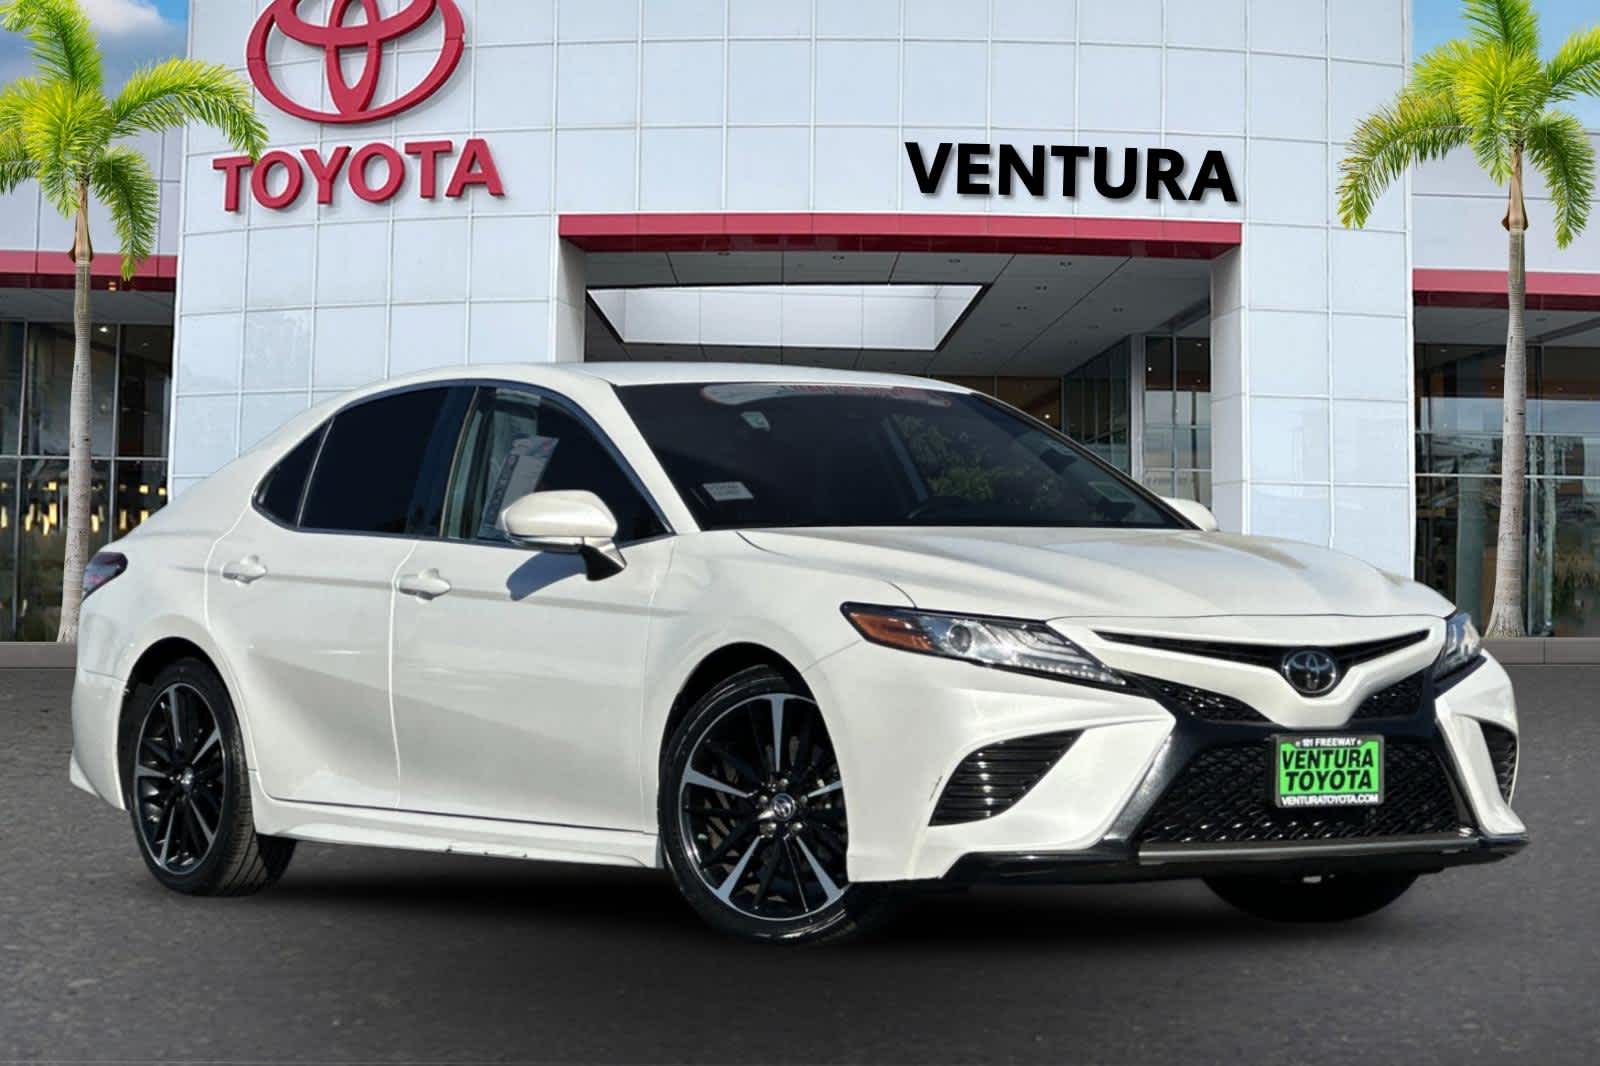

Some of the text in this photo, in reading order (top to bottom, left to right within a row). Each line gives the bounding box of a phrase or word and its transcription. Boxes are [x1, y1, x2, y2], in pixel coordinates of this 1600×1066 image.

[212, 138, 505, 212] TOYOTA
[905, 141, 1238, 203] VENTURA
[1315, 737, 1356, 746] FREEWAY
[1282, 749, 1373, 769] VENTURA
[1286, 770, 1372, 791] TOYOTA
[1282, 794, 1378, 806] VENTURATOYOTA.COM
